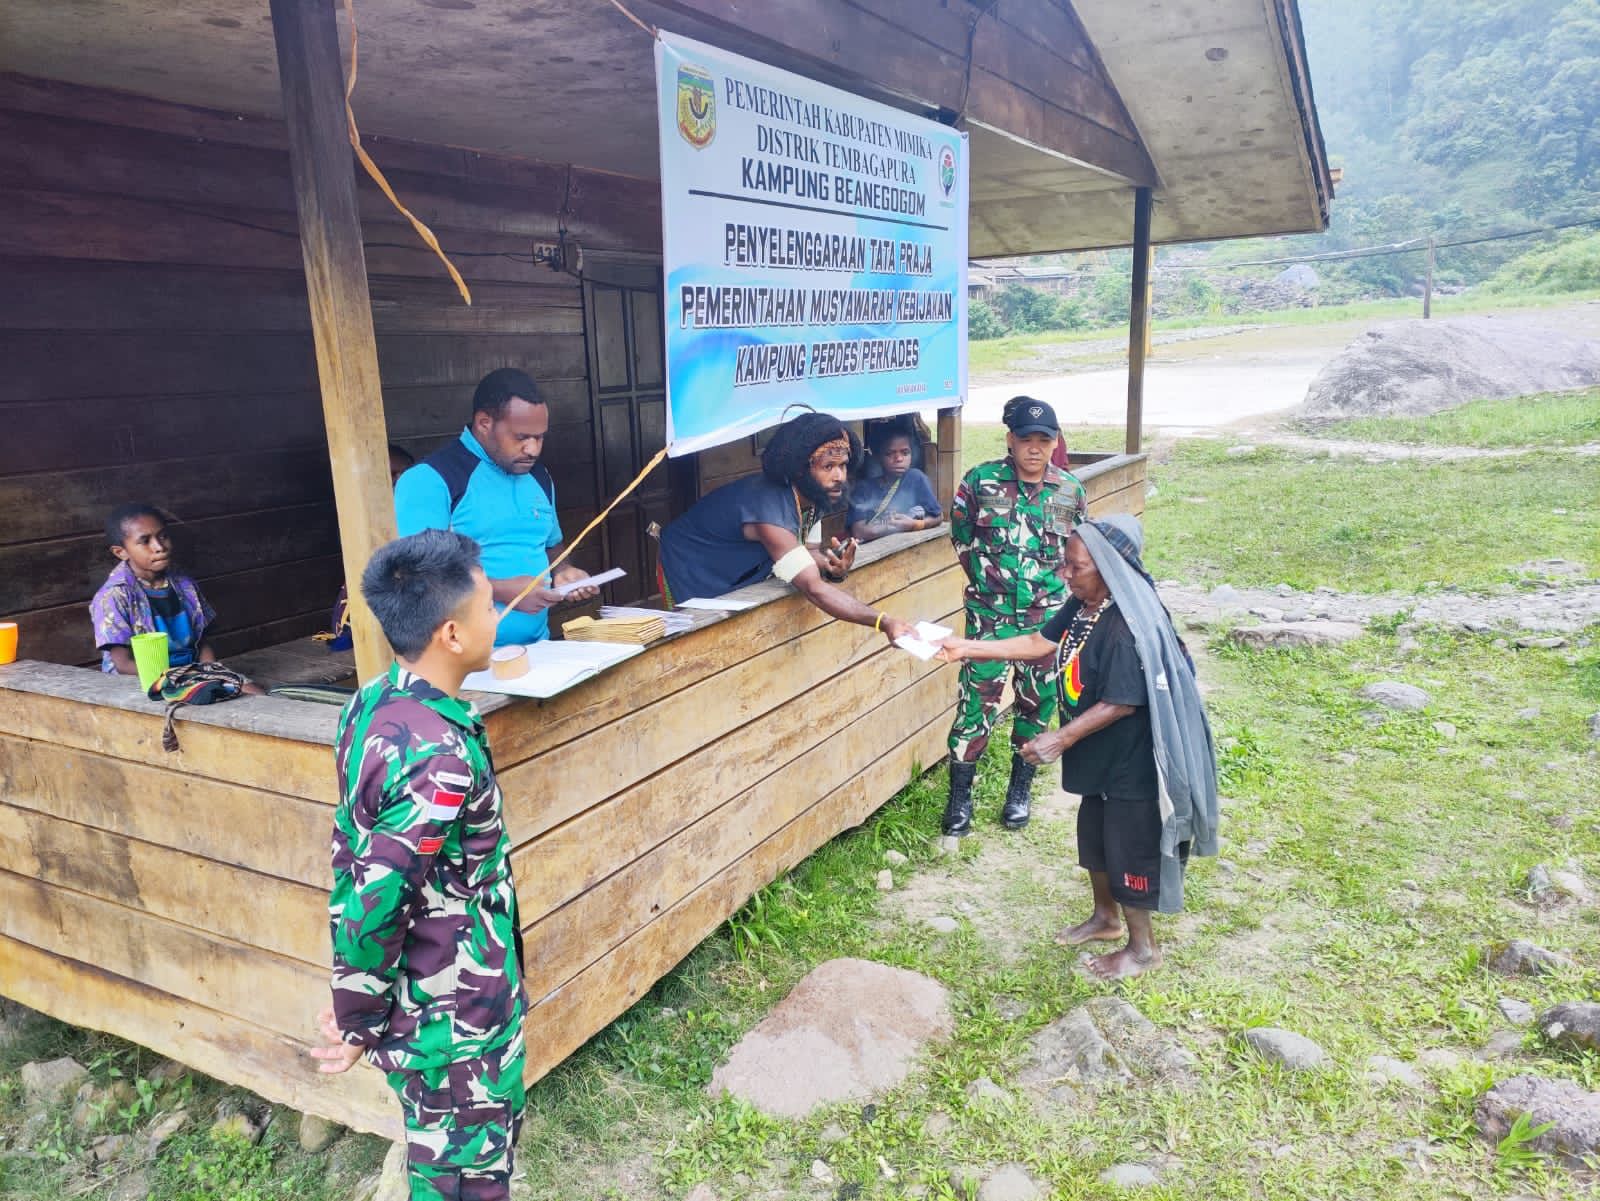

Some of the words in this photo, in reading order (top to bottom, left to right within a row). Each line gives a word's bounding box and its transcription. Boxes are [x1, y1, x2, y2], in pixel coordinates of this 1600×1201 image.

[725, 77, 821, 129] PEMERINTAH
[824, 107, 893, 149] KABUPATEN
[895, 130, 933, 160] MIMIKA
[757, 125, 820, 164] DISTRIK
[823, 142, 916, 185] TEMBAGAPURA
[741, 156, 829, 201] KAMPUNG
[834, 173, 926, 217] BEANEGOGOM
[724, 223, 866, 273] PENYELENGGARAAN
[870, 238, 897, 274] TATA
[899, 240, 933, 277] PRAJA
[680, 285, 806, 329] PEMERINTAHAN
[808, 289, 894, 327] MUSYAWARAH
[896, 291, 952, 322] KEBIJAKAN
[734, 345, 807, 387] KAMPUNG
